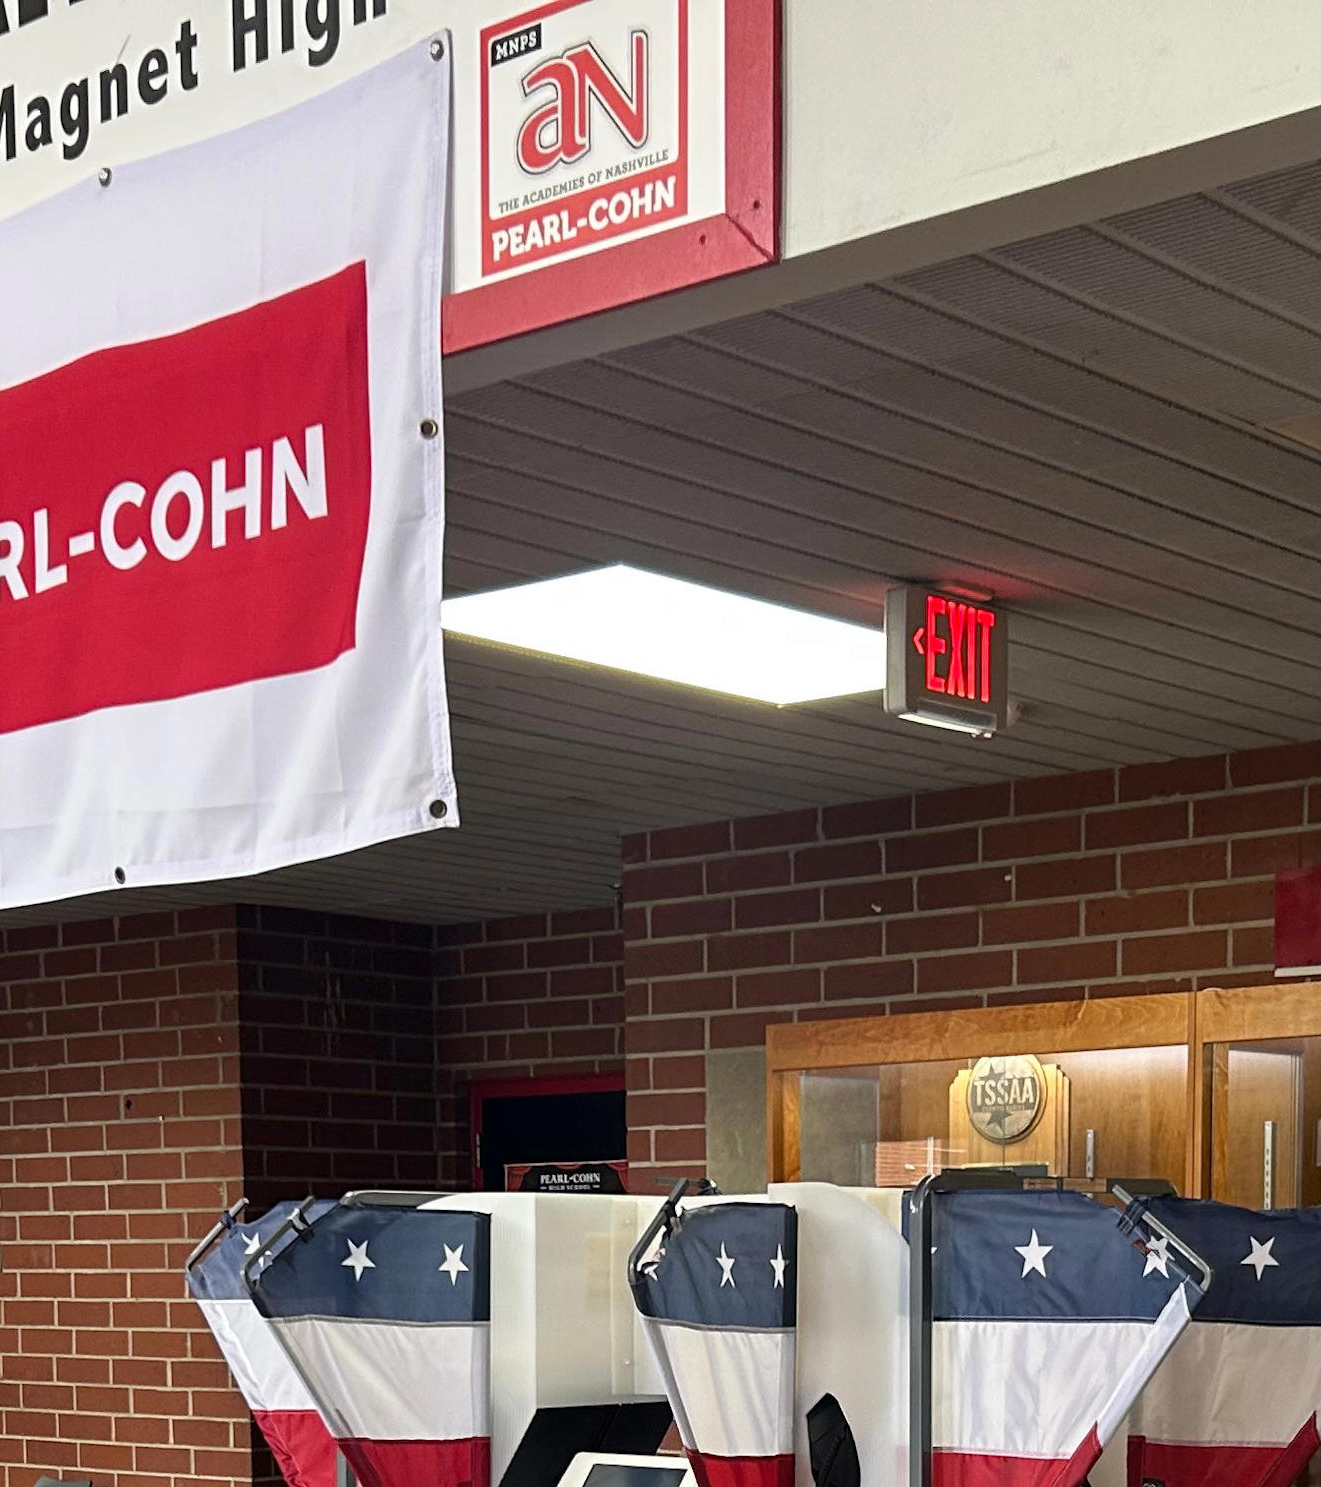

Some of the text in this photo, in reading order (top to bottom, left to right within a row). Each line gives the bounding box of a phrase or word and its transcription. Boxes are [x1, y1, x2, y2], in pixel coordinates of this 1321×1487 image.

[231, 0, 387, 73] Hig
[495, 30, 538, 61] MNPS
[498, 149, 670, 214] THE ACADEMIES OF NASHVILLE
[491, 175, 677, 262] PEARL-COHN
[925, 595, 995, 704] EXIT
[973, 1078, 1035, 1106] TSSAA
